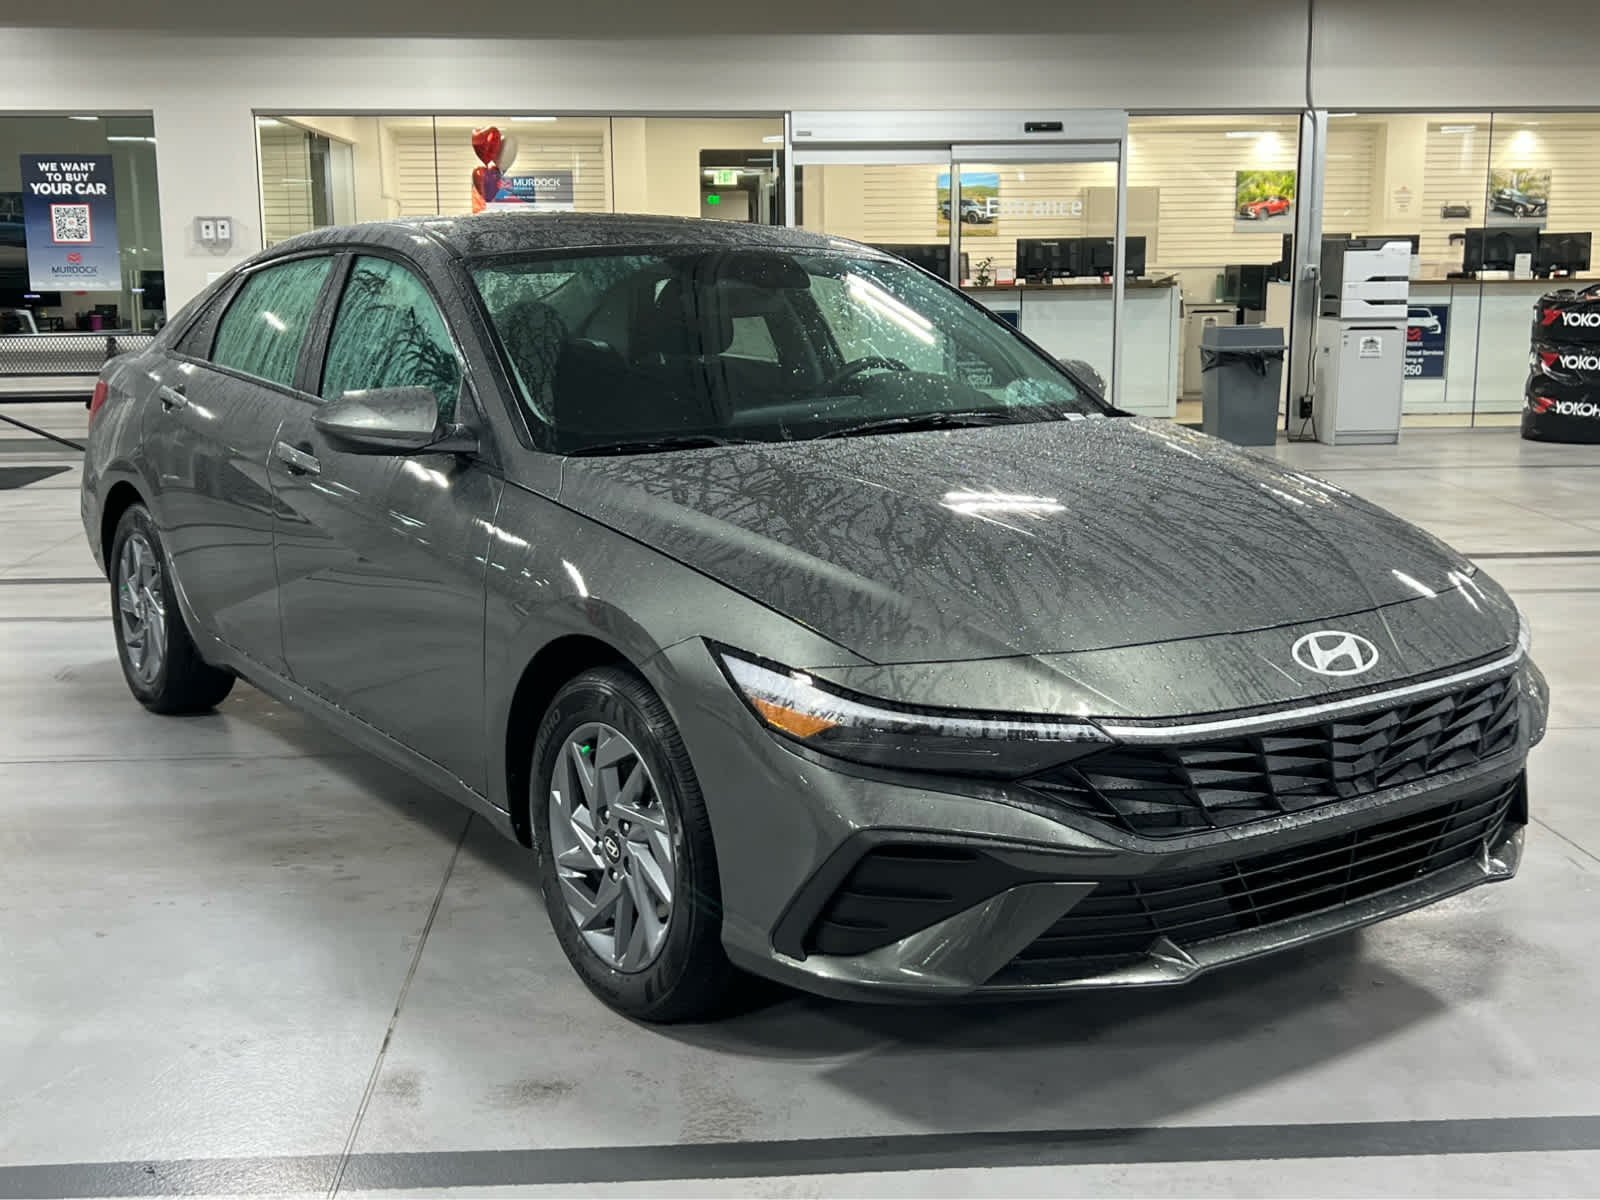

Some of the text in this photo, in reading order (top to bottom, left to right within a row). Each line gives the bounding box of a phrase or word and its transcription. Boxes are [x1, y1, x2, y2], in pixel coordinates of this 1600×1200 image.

[38, 162, 96, 171] WE WANT
[46, 173, 89, 181] TO BUY
[513, 178, 560, 187] MURDOCK
[30, 183, 107, 195] YOUR CAR
[986, 197, 1082, 216] Entrance
